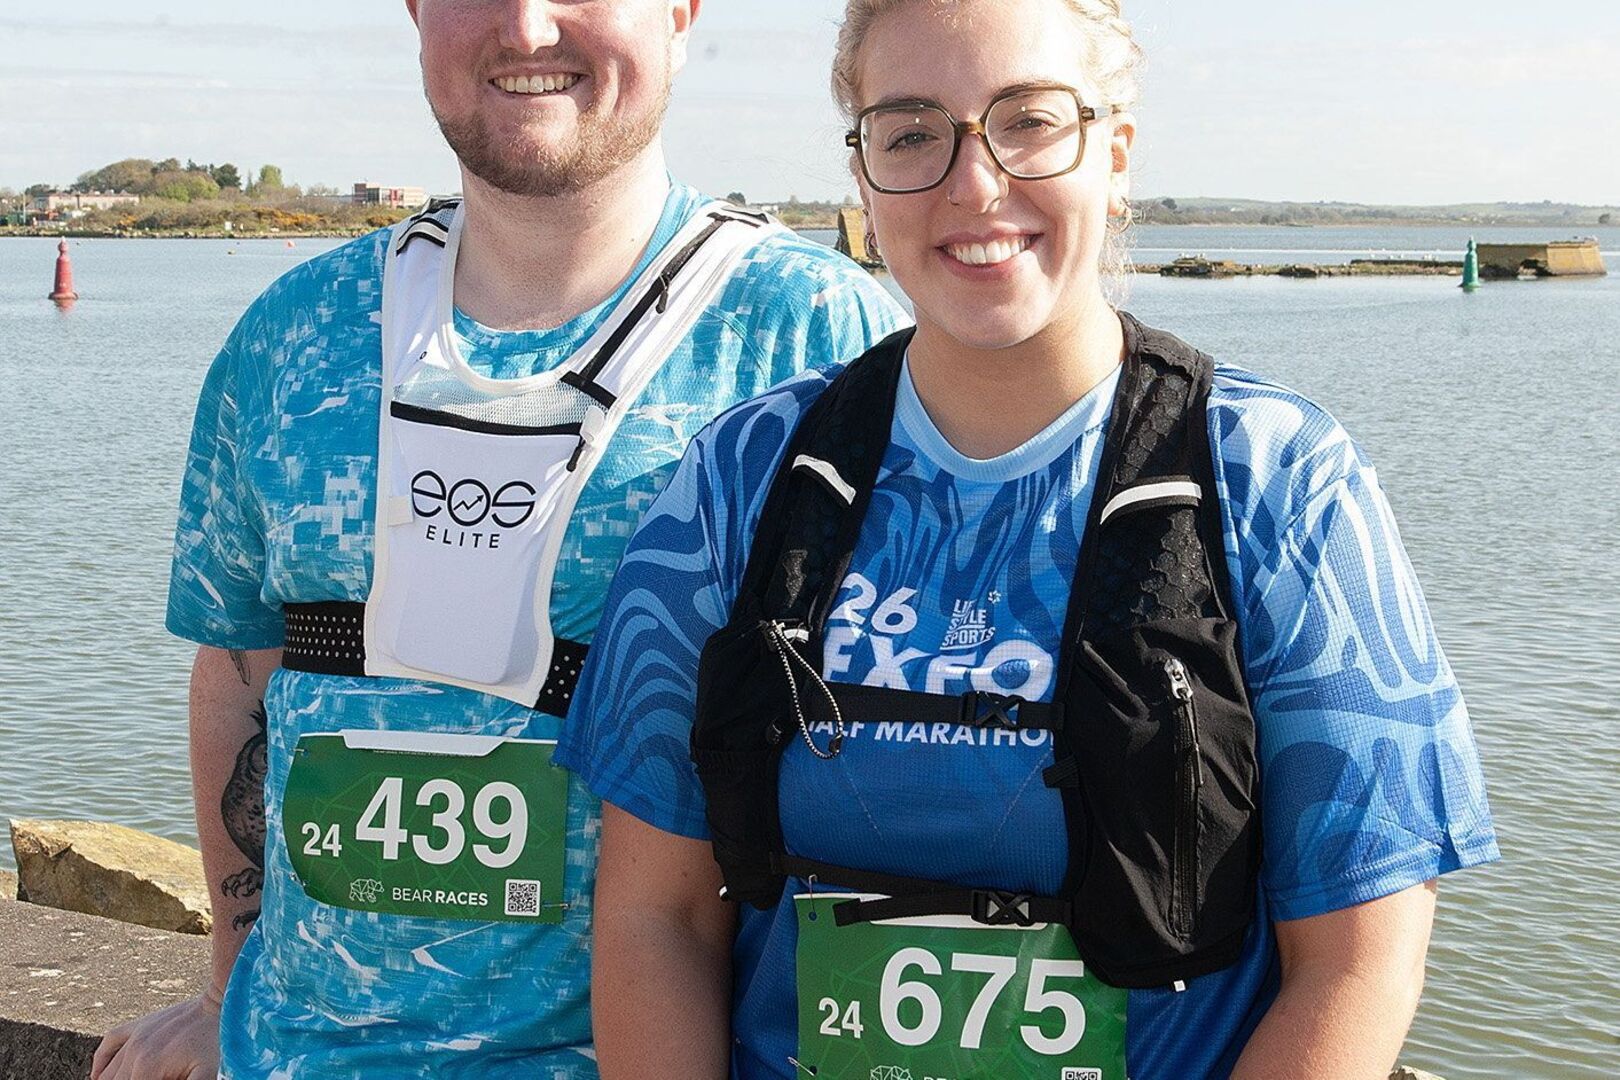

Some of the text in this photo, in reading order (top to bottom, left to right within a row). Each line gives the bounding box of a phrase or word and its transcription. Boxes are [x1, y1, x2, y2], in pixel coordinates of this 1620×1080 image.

[426, 525, 500, 549] ELITE
[941, 626, 996, 647] SPORTS
[807, 721, 1055, 747] ALF MARATHO
[301, 776, 529, 869] 24 439
[392, 887, 488, 906] BEAR RACES
[818, 947, 1086, 1055] 24 675
